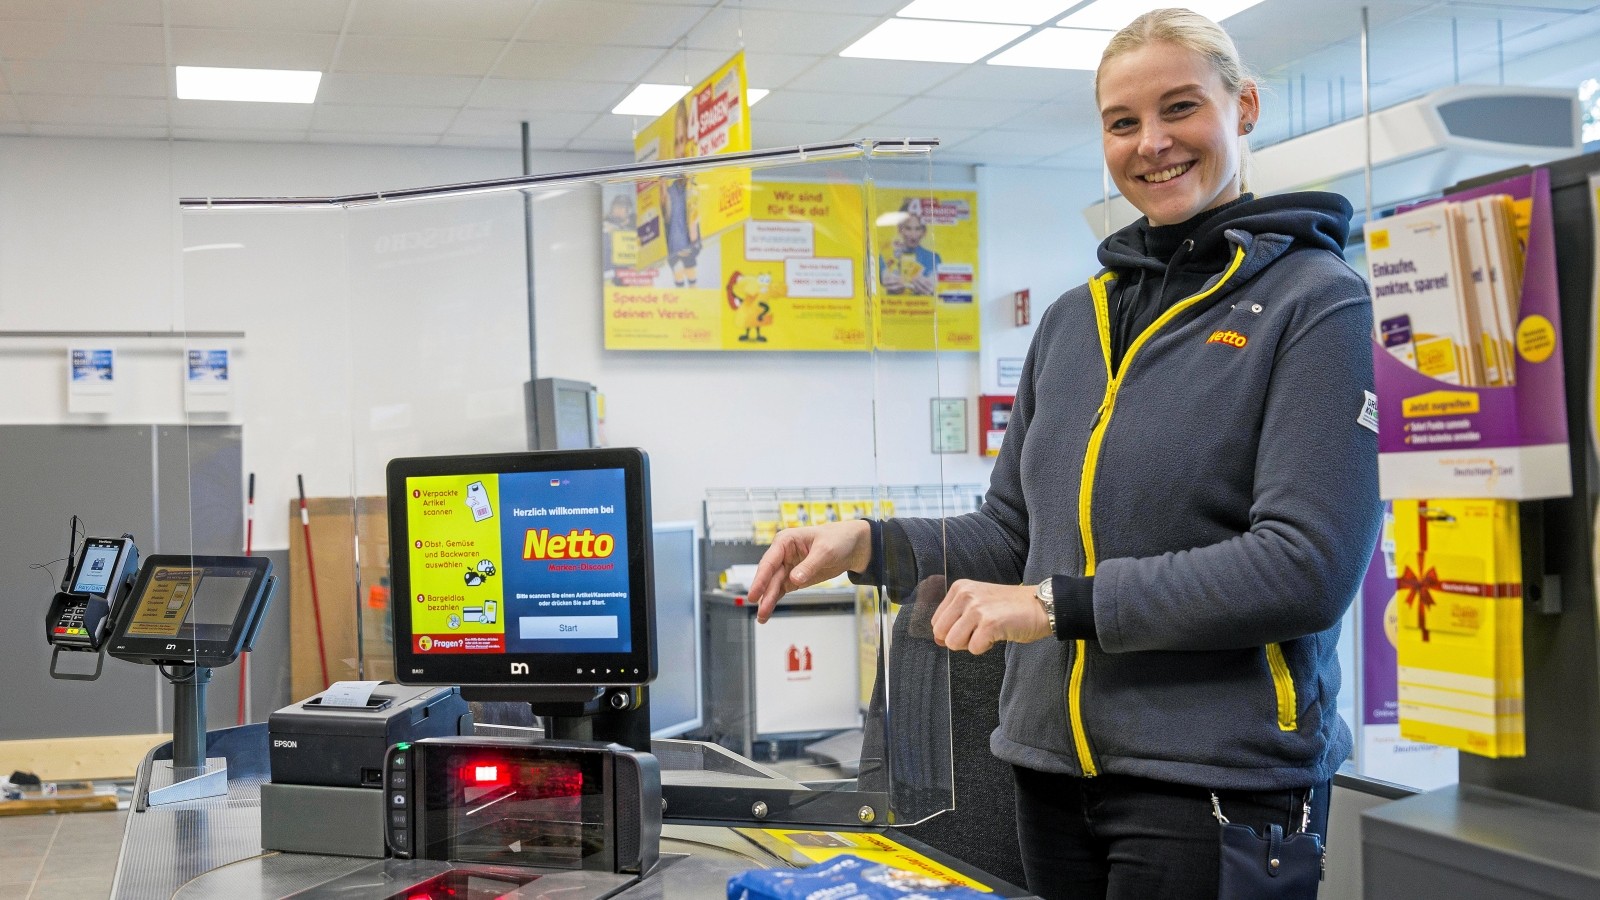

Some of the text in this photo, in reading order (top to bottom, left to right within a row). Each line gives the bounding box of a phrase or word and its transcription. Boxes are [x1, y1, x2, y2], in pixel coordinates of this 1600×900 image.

[774, 191, 823, 202] Wir sind
[768, 205, 829, 216] für Sie da!
[1373, 259, 1416, 278] Einkaufen,
[1375, 273, 1449, 298] punkten, sparen!
[612, 291, 679, 306] Spende für
[612, 307, 699, 320] deinen Verein.
[423, 490, 458, 498] Verpackte
[514, 505, 614, 517] Herzlich willkommen bei
[523, 528, 615, 561] Netto
[428, 595, 465, 603] Bargeldlos
[559, 624, 578, 632] Start
[433, 639, 463, 648] Fragen?
[273, 739, 298, 749] EPSON
